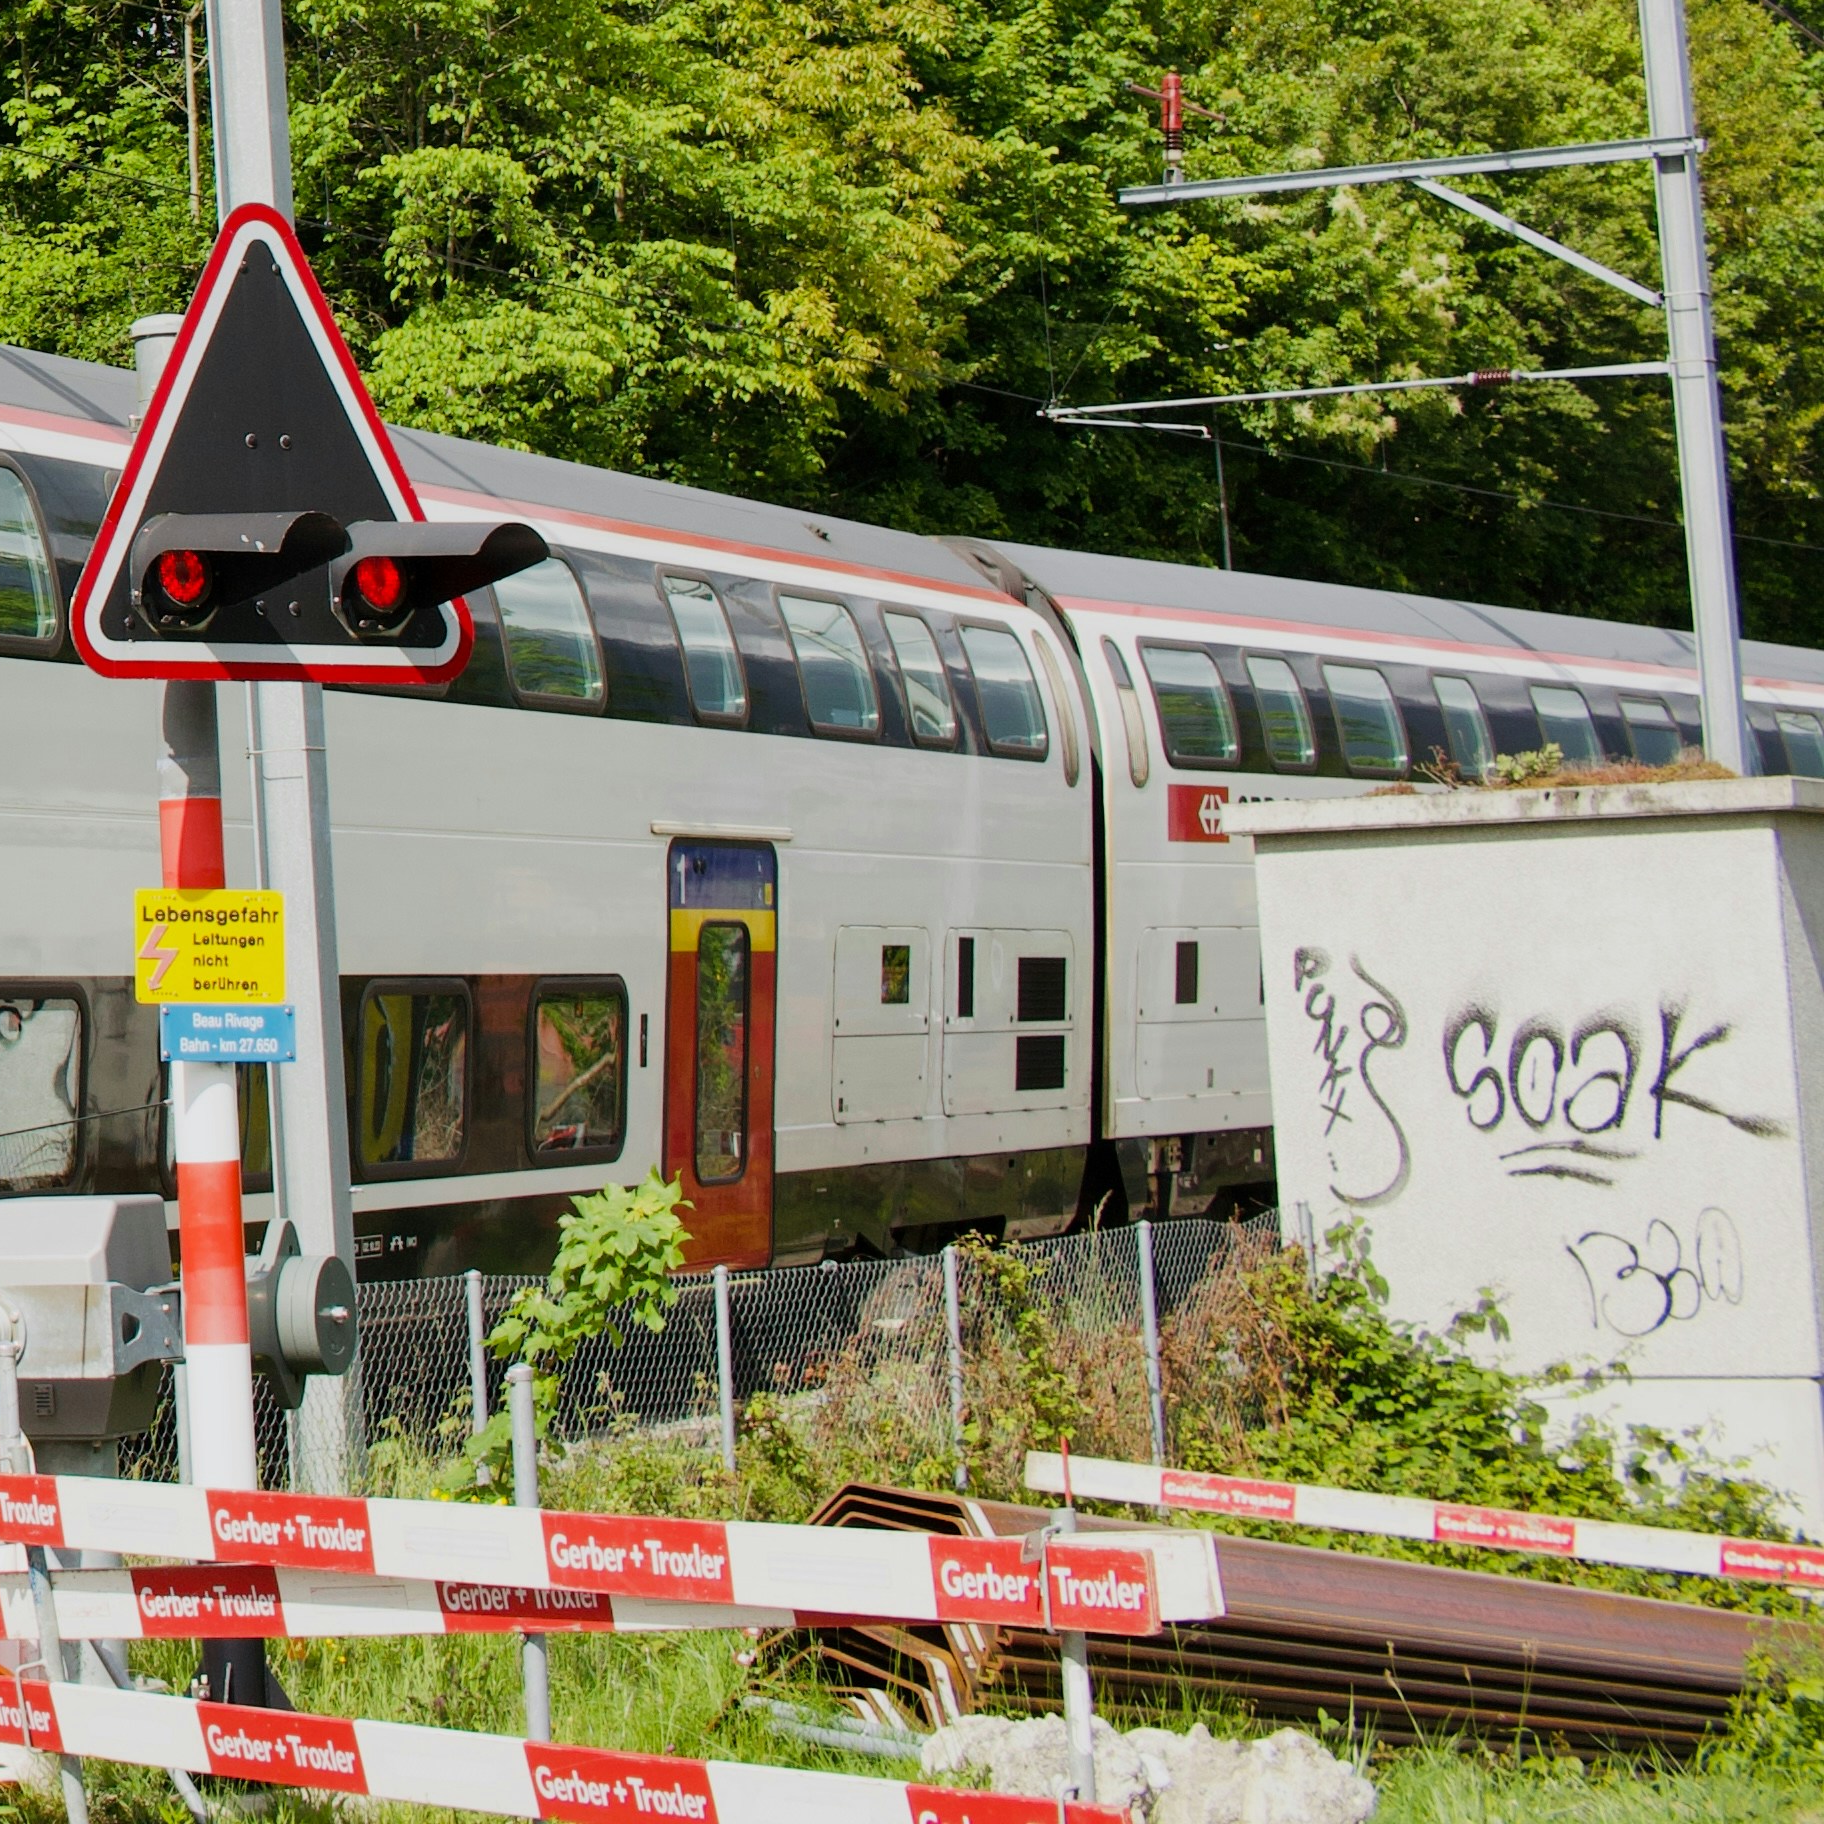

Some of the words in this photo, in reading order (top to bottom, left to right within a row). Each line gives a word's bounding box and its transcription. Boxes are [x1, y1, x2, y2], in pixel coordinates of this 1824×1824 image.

[676, 853, 685, 904] 1
[142, 905, 279, 926] Lebensgefahr
[193, 933, 265, 948] Leitungen
[193, 954, 229, 967] nicht
[193, 977, 259, 990] berühren
[192, 1012, 222, 1028] Beau
[224, 1012, 264, 1031] Rivage
[180, 1037, 210, 1052] Bahn
[219, 1037, 237, 1052] km
[239, 1038, 278, 1053] 27.650
[214, 1508, 281, 1545] Gerber
[295, 1514, 365, 1552] Troxler
[550, 1533, 627, 1573] Gerber
[644, 1539, 725, 1580] Troxler
[139, 1586, 201, 1618] Gerber
[212, 1584, 276, 1618] Troxler
[442, 1581, 512, 1611] Gerber
[940, 1559, 1030, 1602] Gerber
[1050, 1566, 1146, 1611] Troxler
[206, 1723, 272, 1763] Gerber
[285, 1734, 356, 1774] Troxler
[534, 1765, 610, 1807] Gerber
[626, 1776, 707, 1819] Troxler
